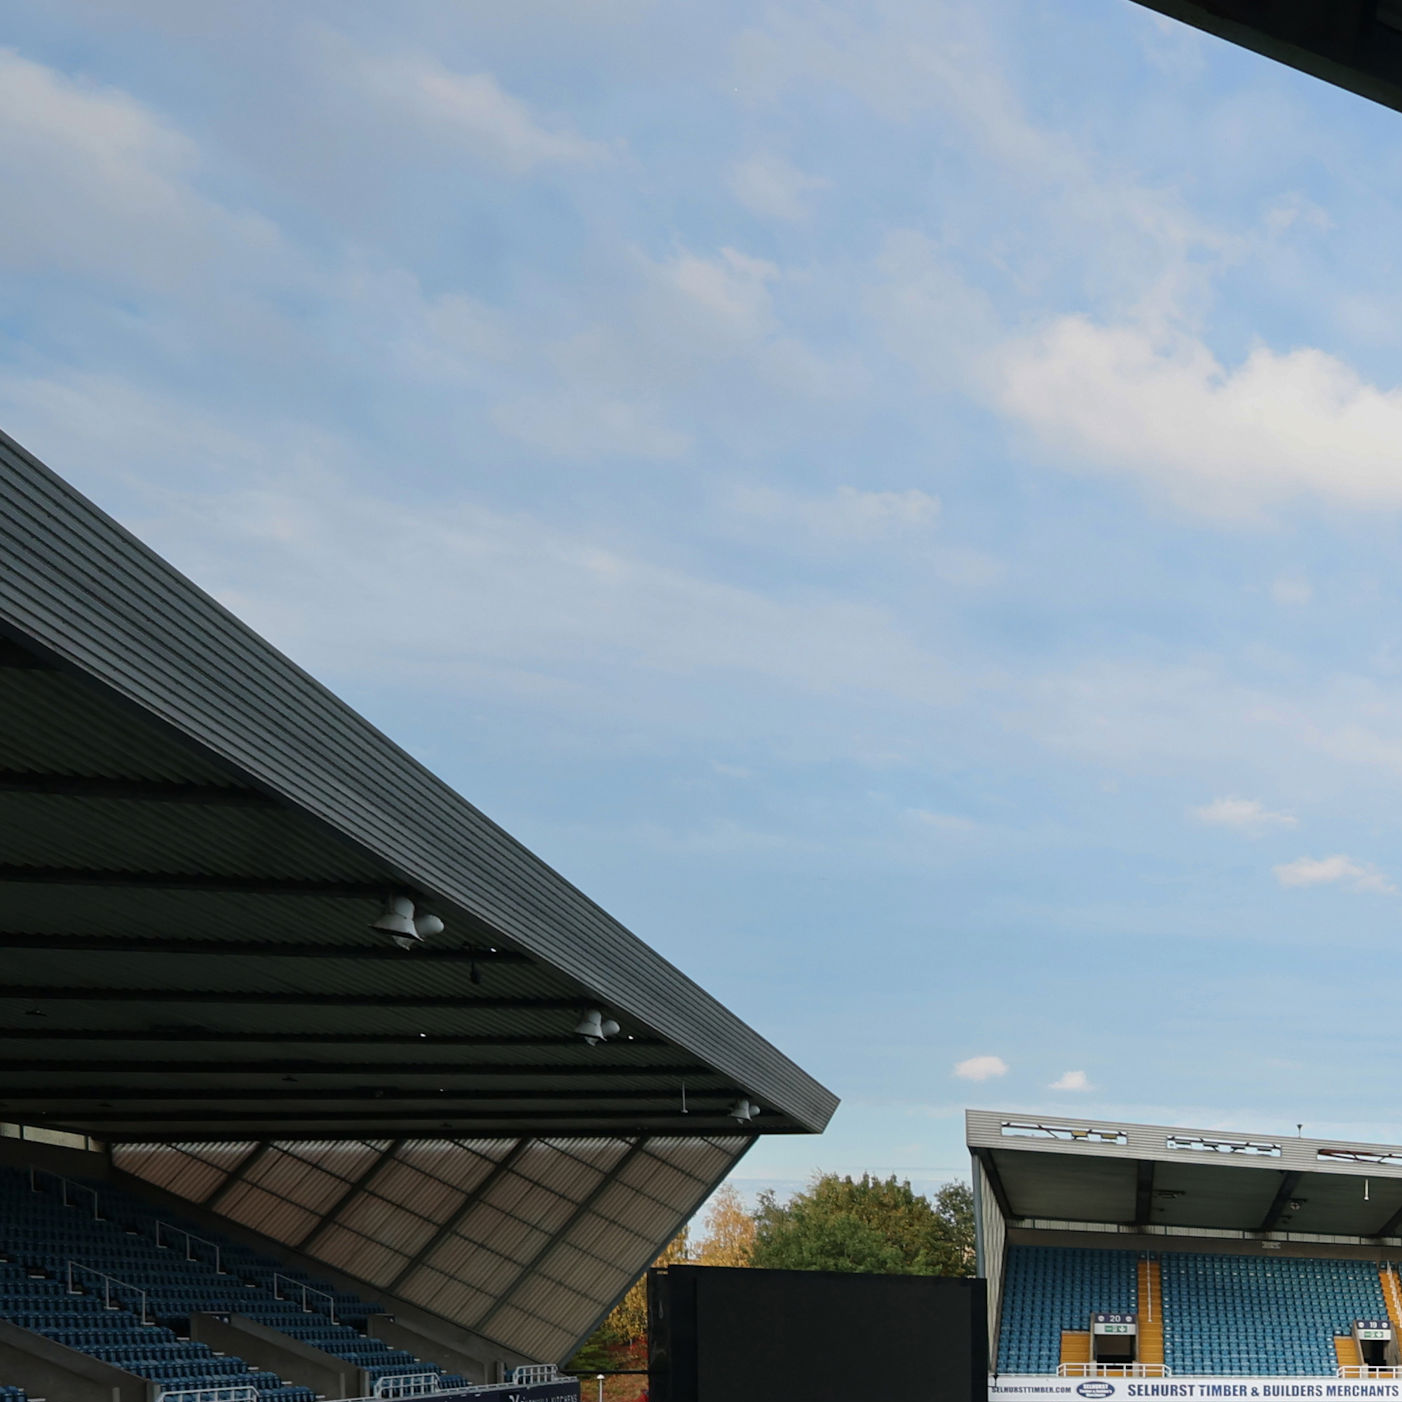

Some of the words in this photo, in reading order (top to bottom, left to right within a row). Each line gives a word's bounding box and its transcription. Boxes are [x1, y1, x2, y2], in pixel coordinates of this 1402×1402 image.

[1128, 1384, 1195, 1397] SELHURST
[1200, 1384, 1247, 1397] TIMBER
[1251, 1386, 1260, 1397] &
[1263, 1384, 1322, 1397] BUILDERS
[1326, 1385, 1399, 1397] MERCHANTS
